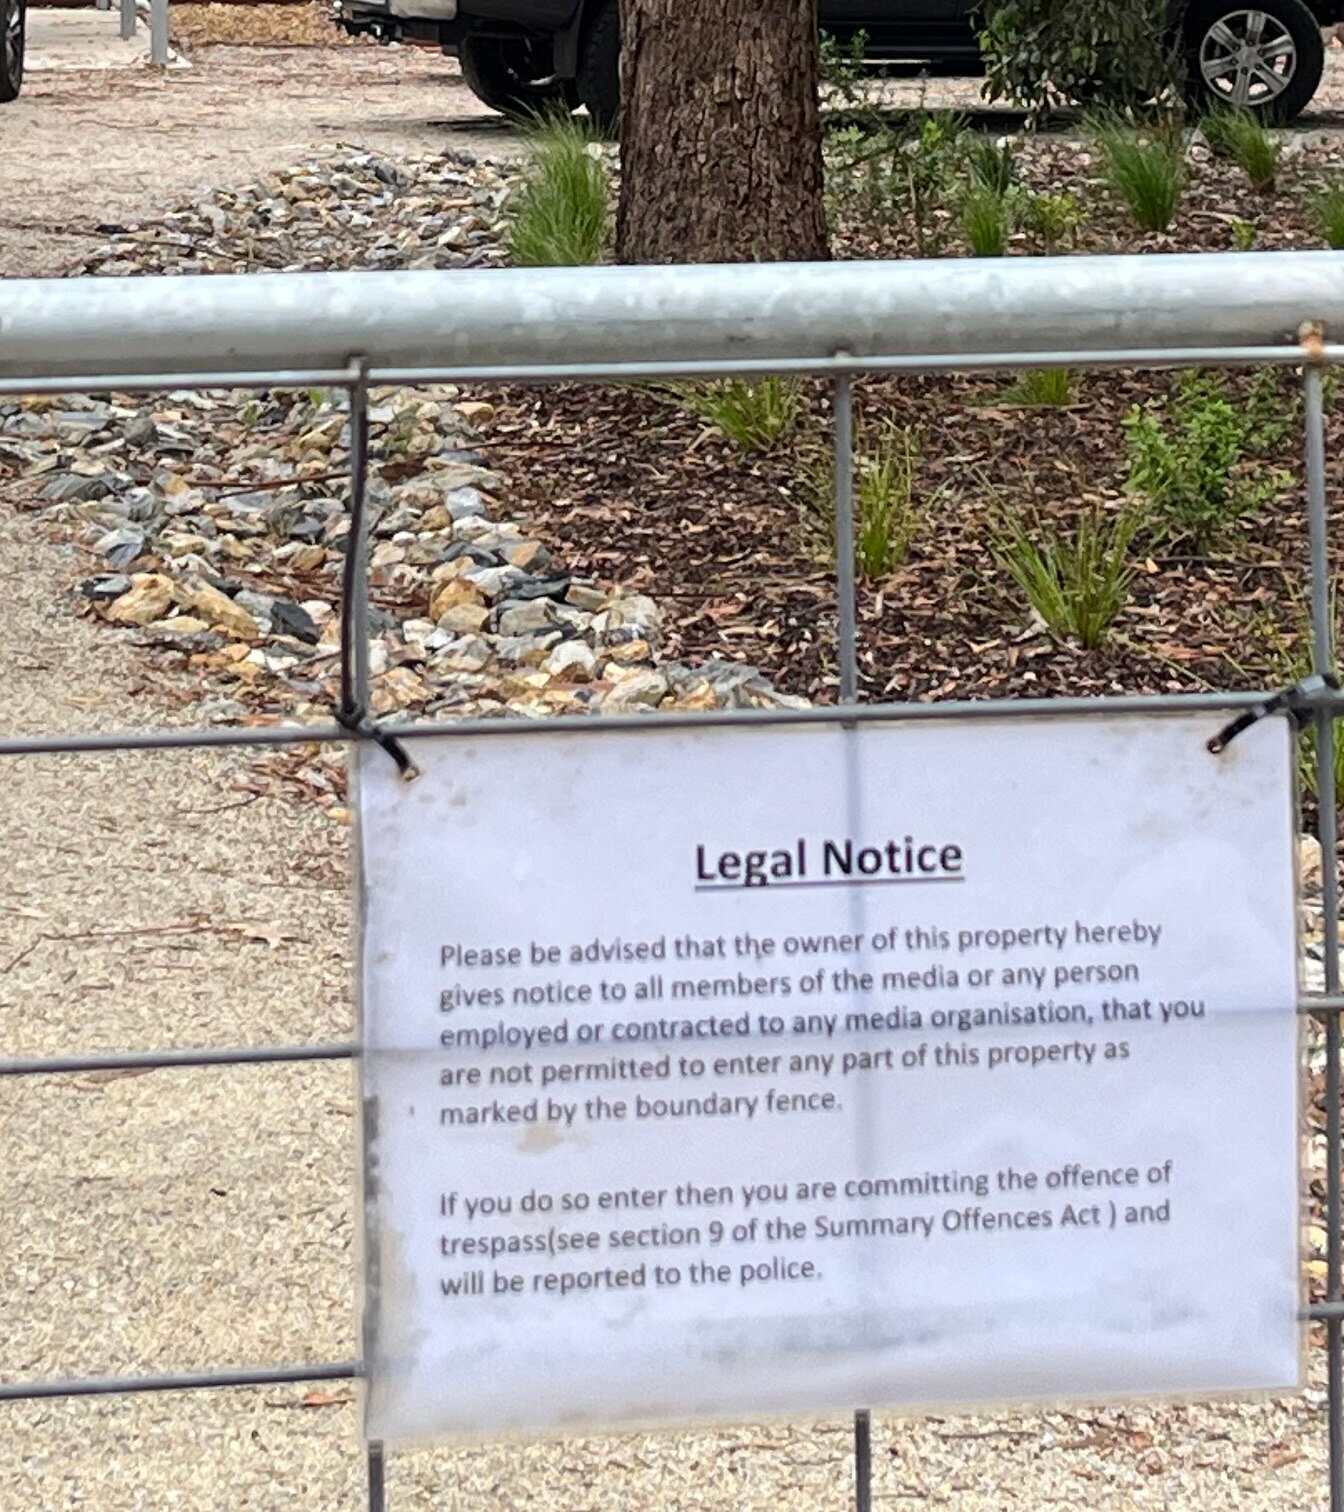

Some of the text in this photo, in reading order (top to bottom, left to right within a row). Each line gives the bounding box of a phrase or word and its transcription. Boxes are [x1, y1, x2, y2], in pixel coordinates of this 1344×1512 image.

[696, 836, 964, 886] Legal Notice
[440, 918, 1162, 969] Please be advised that the owner of this property hereby
[438, 963, 1140, 1014] gives notice to all members of the media or any person
[439, 997, 1206, 1051] employed or contracted to any media organisation, that you
[439, 1039, 1131, 1087] are not permitted to enter any part of this property as
[439, 1088, 842, 1128] marked by the boundary fence.
[439, 1159, 1173, 1222] If you do so enter then you are committing the offence of
[608, 1222, 701, 1250] section
[708, 1220, 725, 1248] 9
[731, 1217, 759, 1244] of
[764, 1215, 807, 1242] the
[814, 1215, 935, 1241] Summary
[941, 1206, 1054, 1234] Offences
[1059, 1203, 1101, 1228] Act
[1124, 1197, 1171, 1225] and
[439, 1255, 823, 1298] will be reported to the police.
